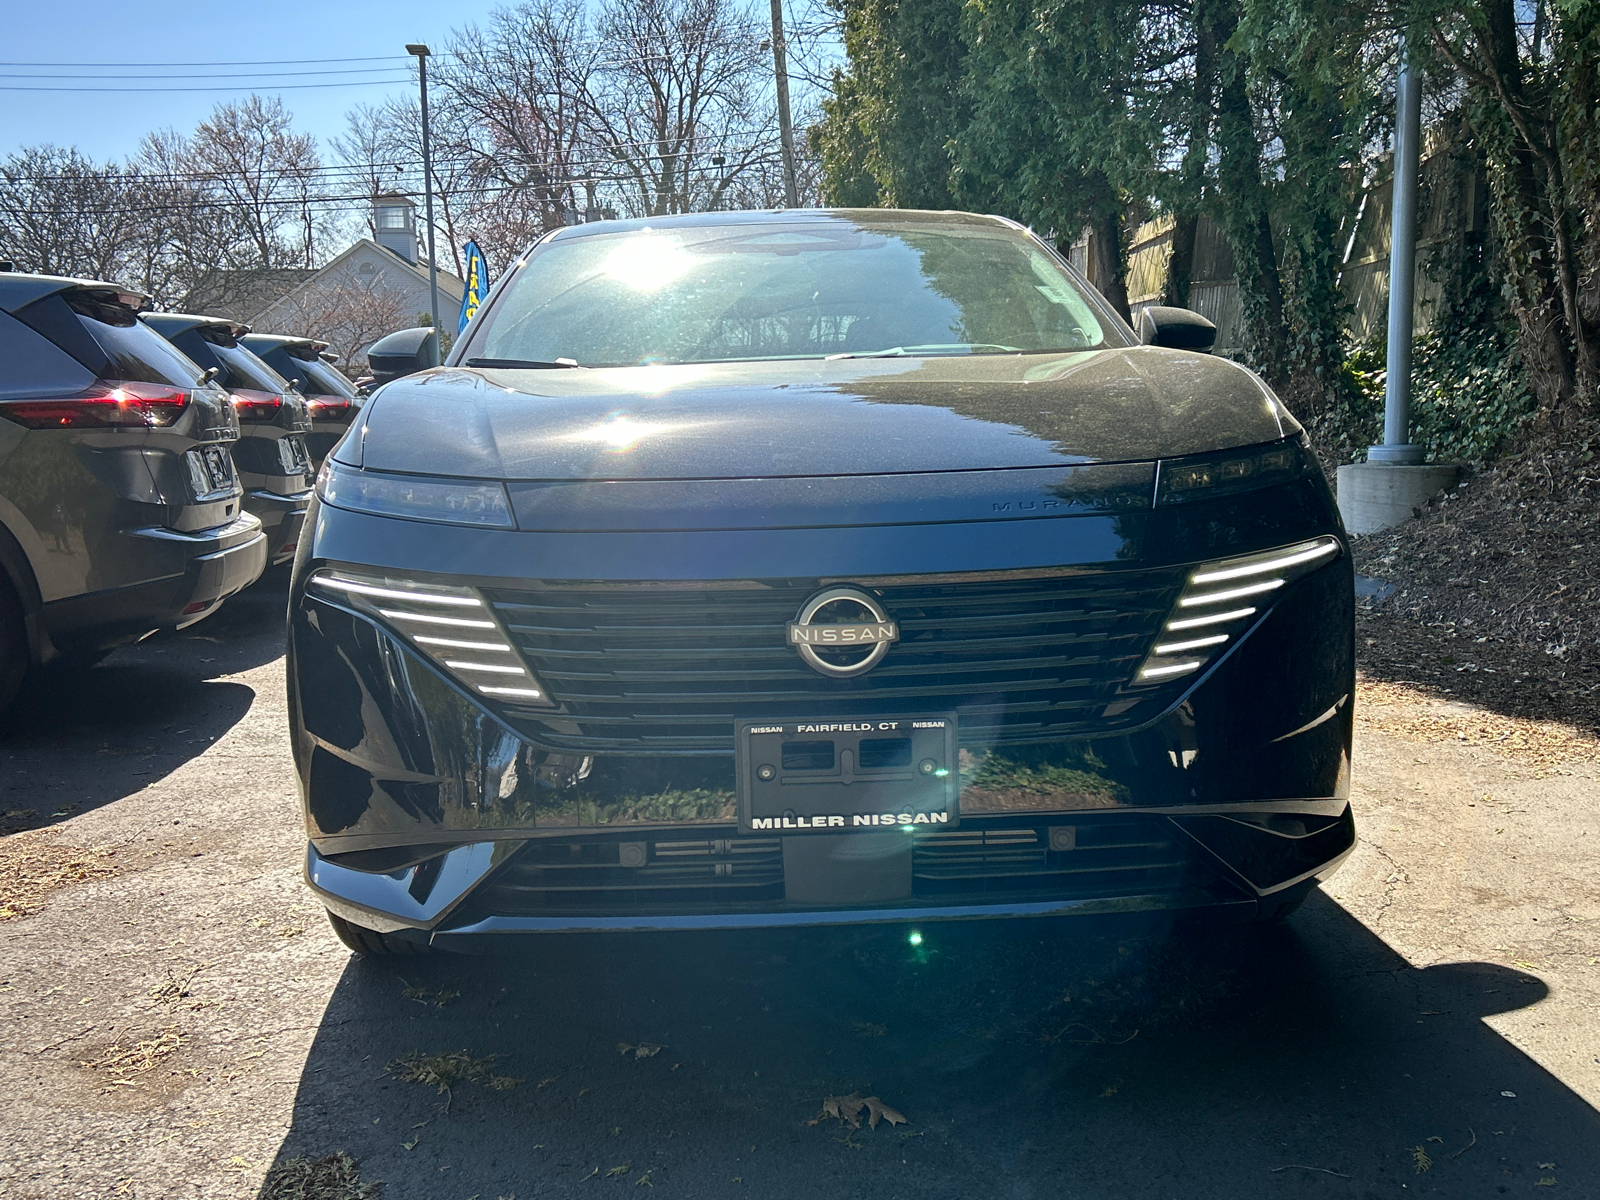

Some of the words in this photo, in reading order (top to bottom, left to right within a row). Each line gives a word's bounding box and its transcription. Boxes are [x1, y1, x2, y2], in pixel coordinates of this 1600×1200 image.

[993, 497, 1131, 512] MURANO
[794, 625, 893, 641] NISSAN
[751, 726, 783, 734] NISSAN
[797, 723, 875, 733] FAIRFIELD,
[878, 722, 899, 731] CT
[912, 721, 945, 729] NISSAN
[752, 815, 845, 829] MILLER
[853, 812, 948, 826] NISSAN
